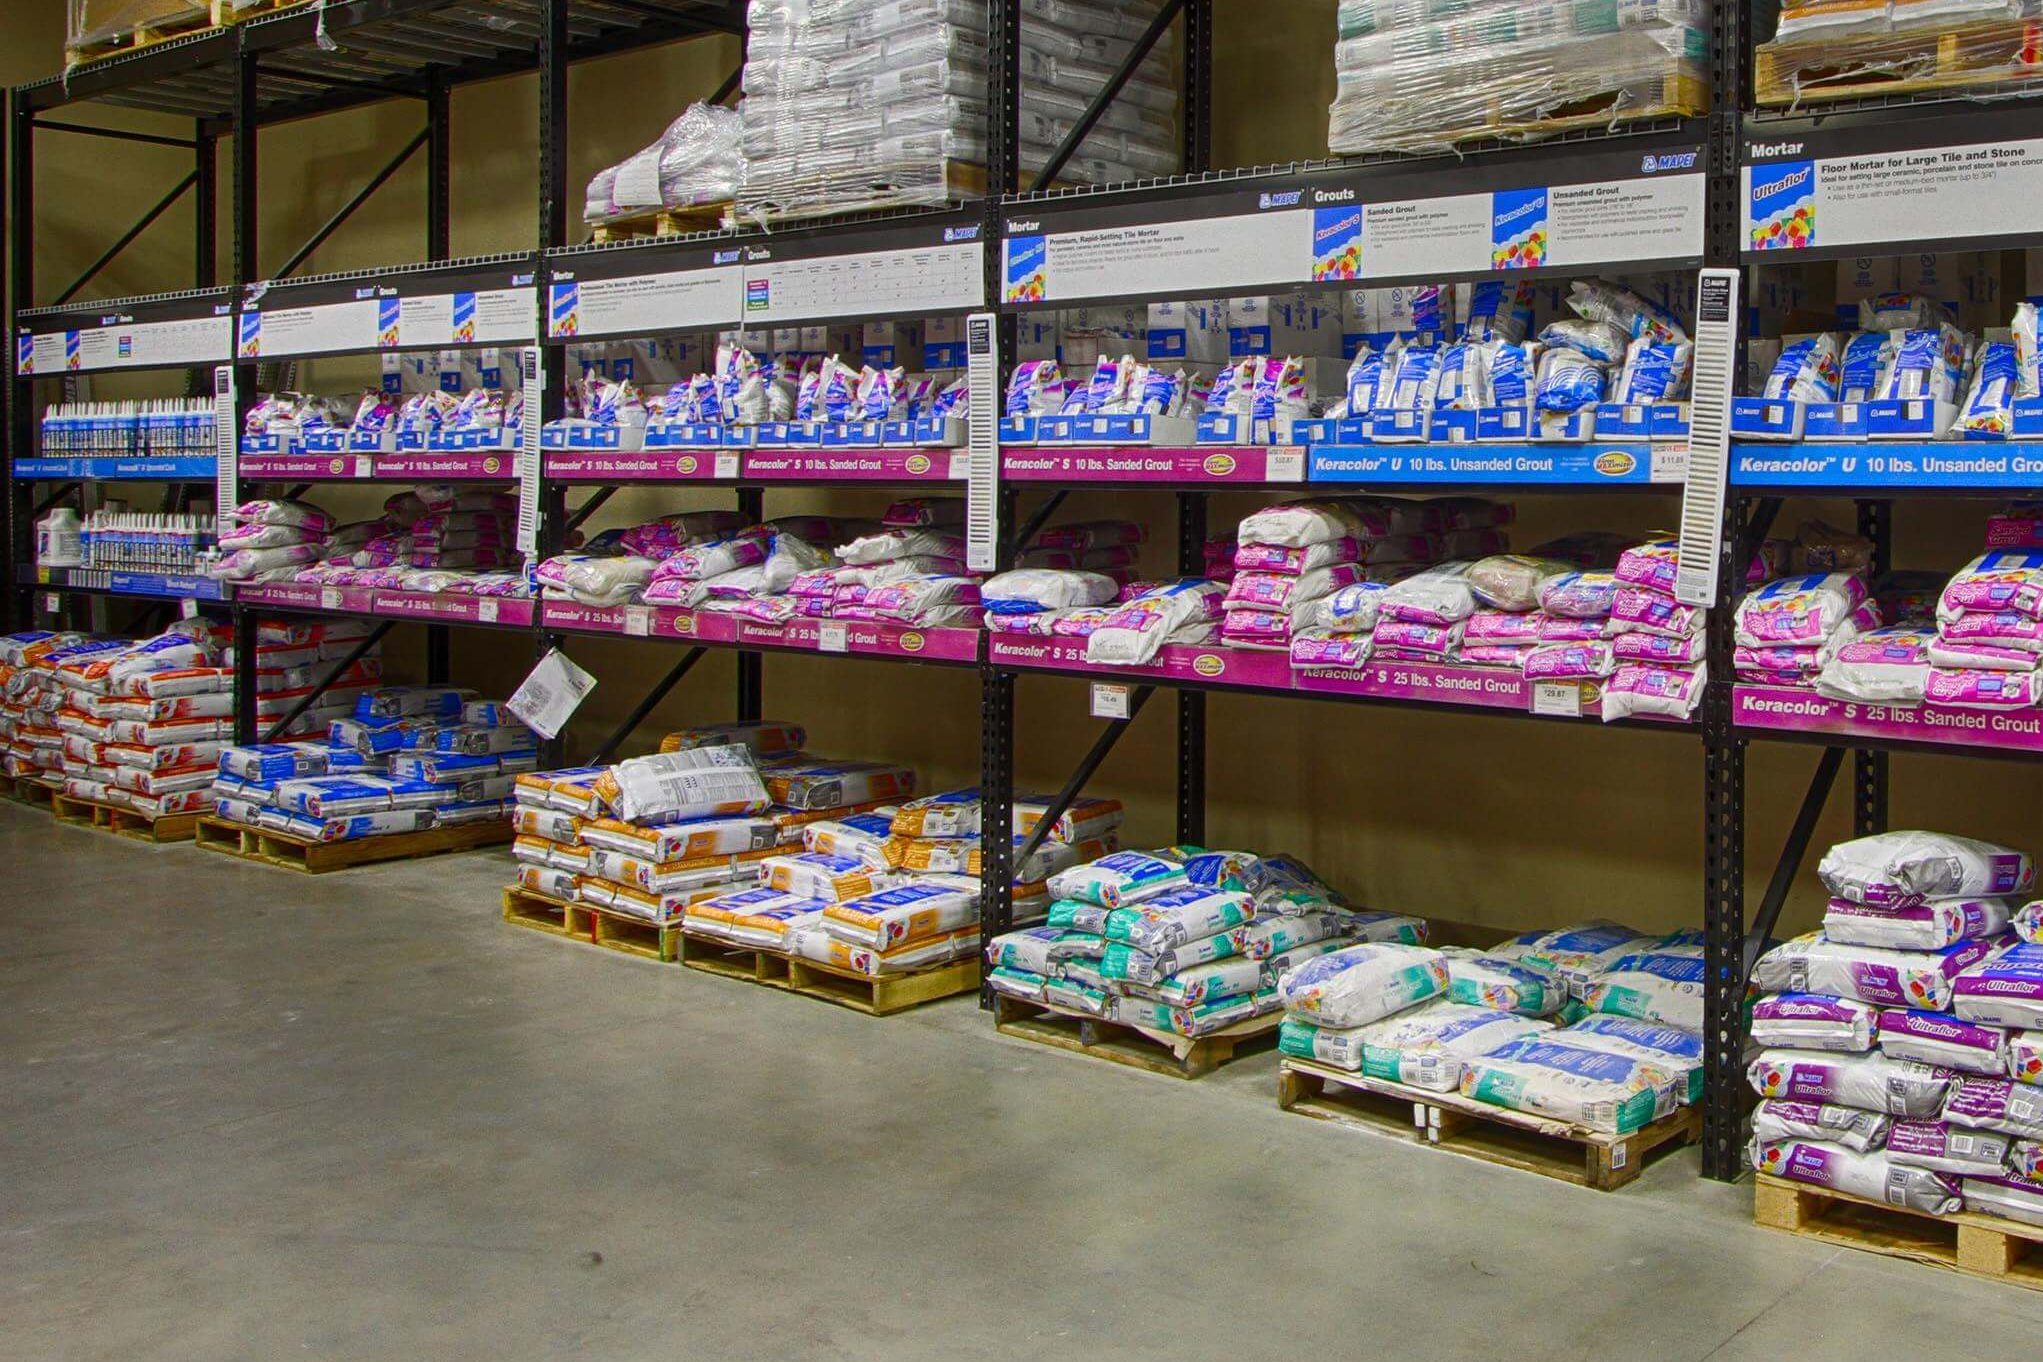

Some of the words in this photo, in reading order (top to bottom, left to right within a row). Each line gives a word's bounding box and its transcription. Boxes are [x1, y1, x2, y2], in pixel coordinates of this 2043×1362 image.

[1751, 142, 1804, 158] Mortar
[1657, 153, 1696, 170] MAPEI
[1821, 164, 1847, 173] Floor
[1850, 160, 1884, 171] Mortar
[1888, 158, 1903, 168] for
[1906, 156, 1937, 166] Large
[1942, 153, 1962, 162] Tile
[1966, 151, 1987, 160] and
[1991, 148, 2025, 158] Stone
[1753, 170, 1807, 201] Ultraflor
[1315, 188, 1355, 202] Grouts
[1553, 191, 1594, 199] Unsanded
[1596, 187, 1619, 196] Grout
[1367, 207, 1394, 216] Sanded
[1395, 205, 1416, 214] Grout
[1008, 220, 1040, 233] Mortar
[794, 459, 801, 470] S
[805, 460, 813, 470] 10
[815, 459, 828, 470] lbs.
[830, 459, 858, 470] Sanded
[859, 459, 881, 470] Grout
[1063, 459, 1070, 469] S
[1076, 460, 1085, 469] 10
[1088, 459, 1104, 469] lbs.
[1107, 459, 1142, 470] Sanded
[1145, 459, 1172, 470] Grout
[1391, 458, 1402, 470] U
[1410, 459, 1422, 470] 10
[1426, 458, 1447, 470] lbs.
[1451, 457, 1516, 470] Unsanded
[1520, 458, 1553, 471] Grout
[1842, 457, 1857, 472] U
[1867, 458, 1884, 471] 10
[1889, 457, 1917, 472] lbs.
[1922, 457, 2007, 472] Unsanded
[790, 628, 796, 638] S
[800, 629, 809, 639] 25
[855, 634, 877, 644] Grout
[1053, 649, 1060, 659] S
[1066, 650, 1077, 660] 25
[1378, 670, 1387, 683] S
[1394, 673, 1408, 685] 25
[1411, 674, 1432, 687] lbs.
[1435, 675, 1481, 691] Sanded
[1485, 680, 1521, 694] Grout
[1844, 704, 1857, 718] S
[1867, 706, 1885, 721] 25
[1891, 707, 1919, 724] lbs.
[1924, 709, 1986, 729] Sanded
[1991, 715, 2041, 733] Grout
[1861, 986, 1898, 999] Ultraflor
[1986, 980, 2040, 994] Ultraflor
[1779, 1004, 1821, 1015] Ultraflor
[1910, 1020, 1962, 1037] Ultraflor
[1795, 1083, 1833, 1095] Ultraflor
[1793, 1164, 1832, 1181] Ultraflor
